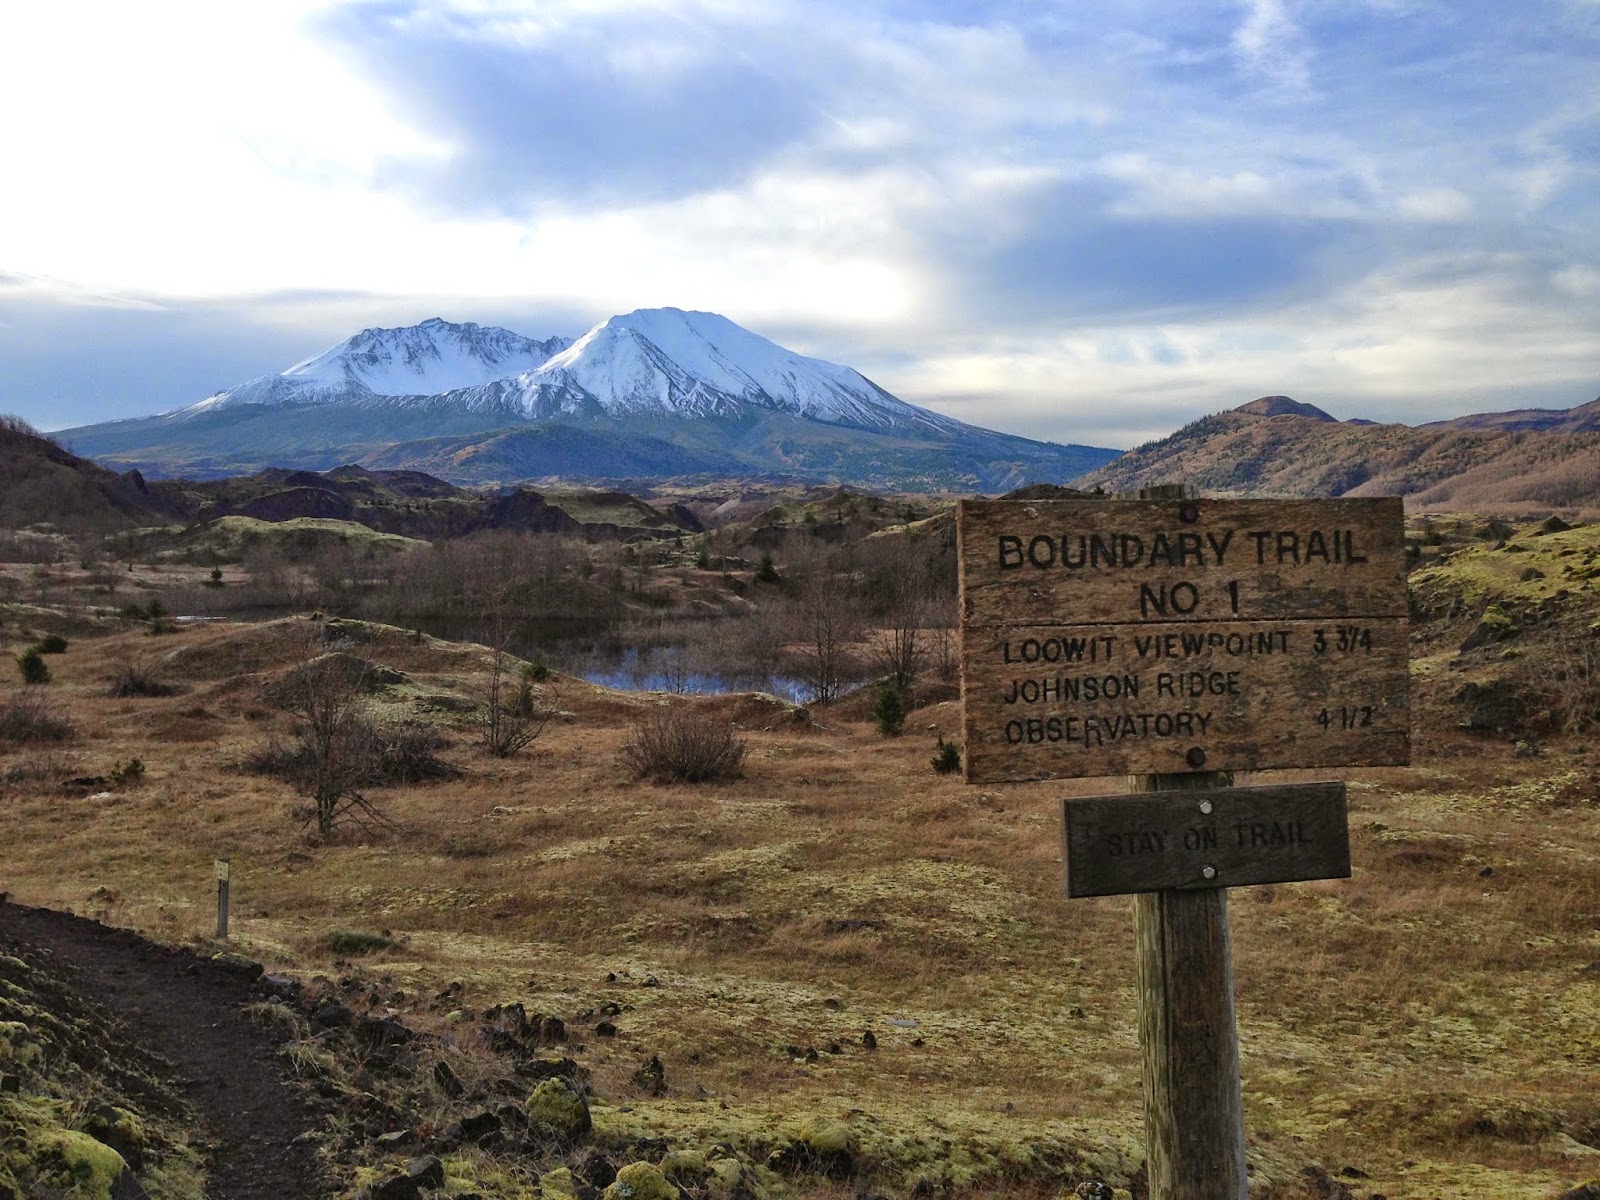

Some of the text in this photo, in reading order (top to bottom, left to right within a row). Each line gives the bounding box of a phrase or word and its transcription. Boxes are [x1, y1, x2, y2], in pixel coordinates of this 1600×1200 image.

[999, 529, 1368, 570] BOUNDARY TRAIL
[1139, 581, 1197, 616] NO
[1003, 635, 1117, 664] LOOWIT
[1134, 630, 1293, 659] VIEWPOINT
[1313, 629, 1328, 654] 3
[1004, 671, 1241, 705] JOHNSON RIDGE
[1005, 706, 1374, 748] OBSERVATORY 4 1/2
[1106, 821, 1313, 857] STAY ON TRAIL
